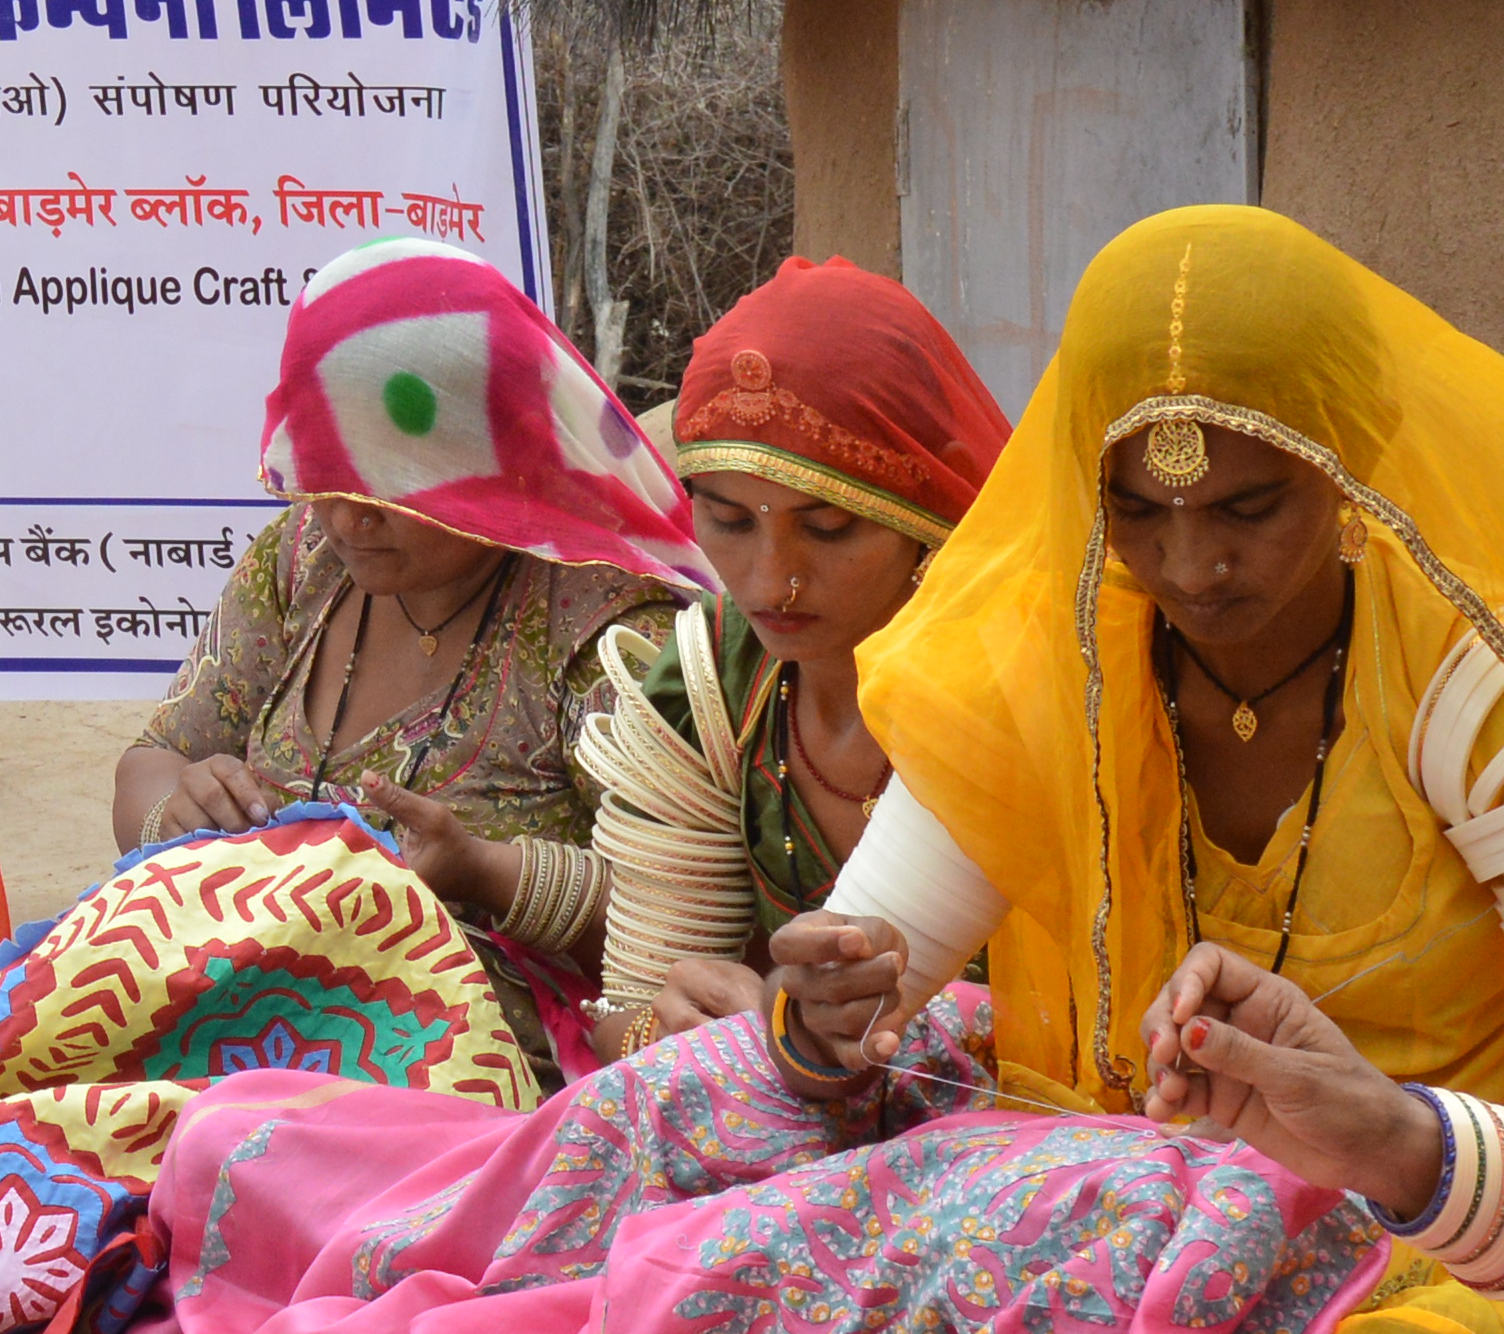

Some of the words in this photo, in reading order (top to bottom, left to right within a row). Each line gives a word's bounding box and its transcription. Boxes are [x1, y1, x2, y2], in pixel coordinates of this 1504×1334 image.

[89, 72, 237, 115] संपोषण
[258, 72, 446, 119] परियोजना
[125, 175, 263, 235] ब्लॉक,
[13, 267, 181, 314] Applique
[194, 267, 290, 306] Craft
[19, 524, 91, 566] बैंक
[90, 596, 212, 646] इकोनो
